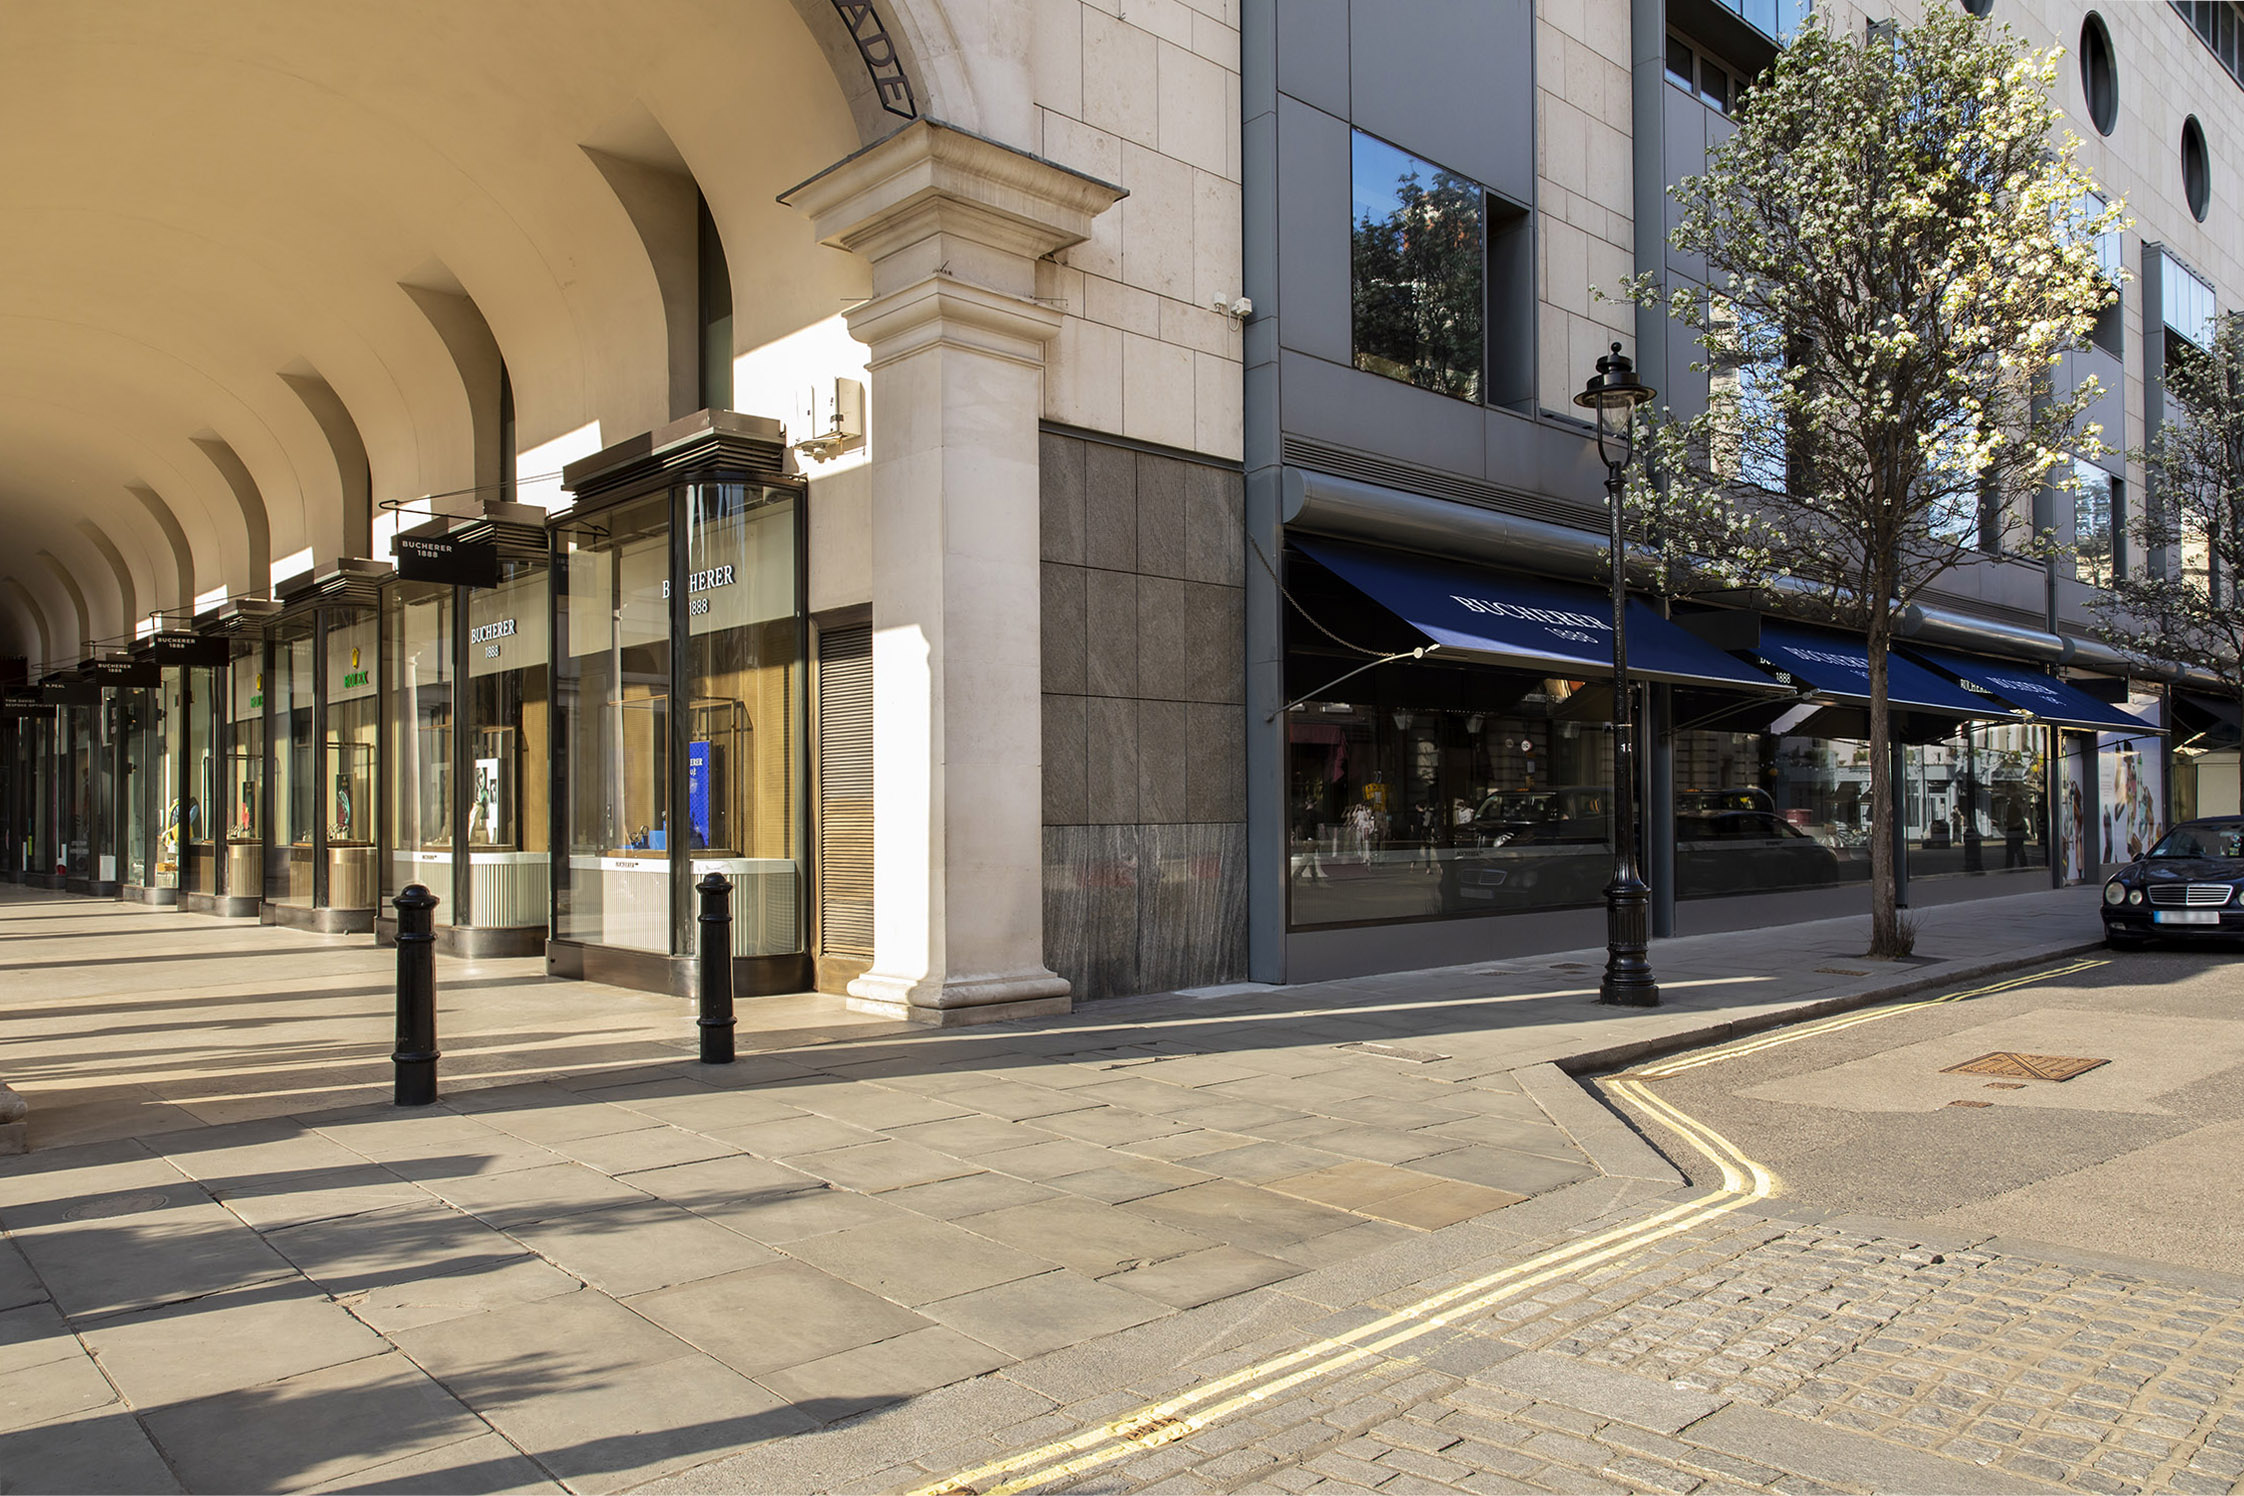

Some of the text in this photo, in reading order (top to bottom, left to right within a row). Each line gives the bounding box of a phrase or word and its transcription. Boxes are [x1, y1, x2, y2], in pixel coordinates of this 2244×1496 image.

[402, 540, 452, 552] BUCHERER
[417, 549, 438, 558] 1888
[689, 598, 708, 616] 1888
[1449, 594, 1614, 631] BUCHERER
[471, 618, 516, 644] BUCHERER
[1544, 626, 1598, 644] 1888
[485, 644, 500, 658] 1888
[344, 671, 369, 689] ROLEX
[1776, 672, 1791, 684] 1888
